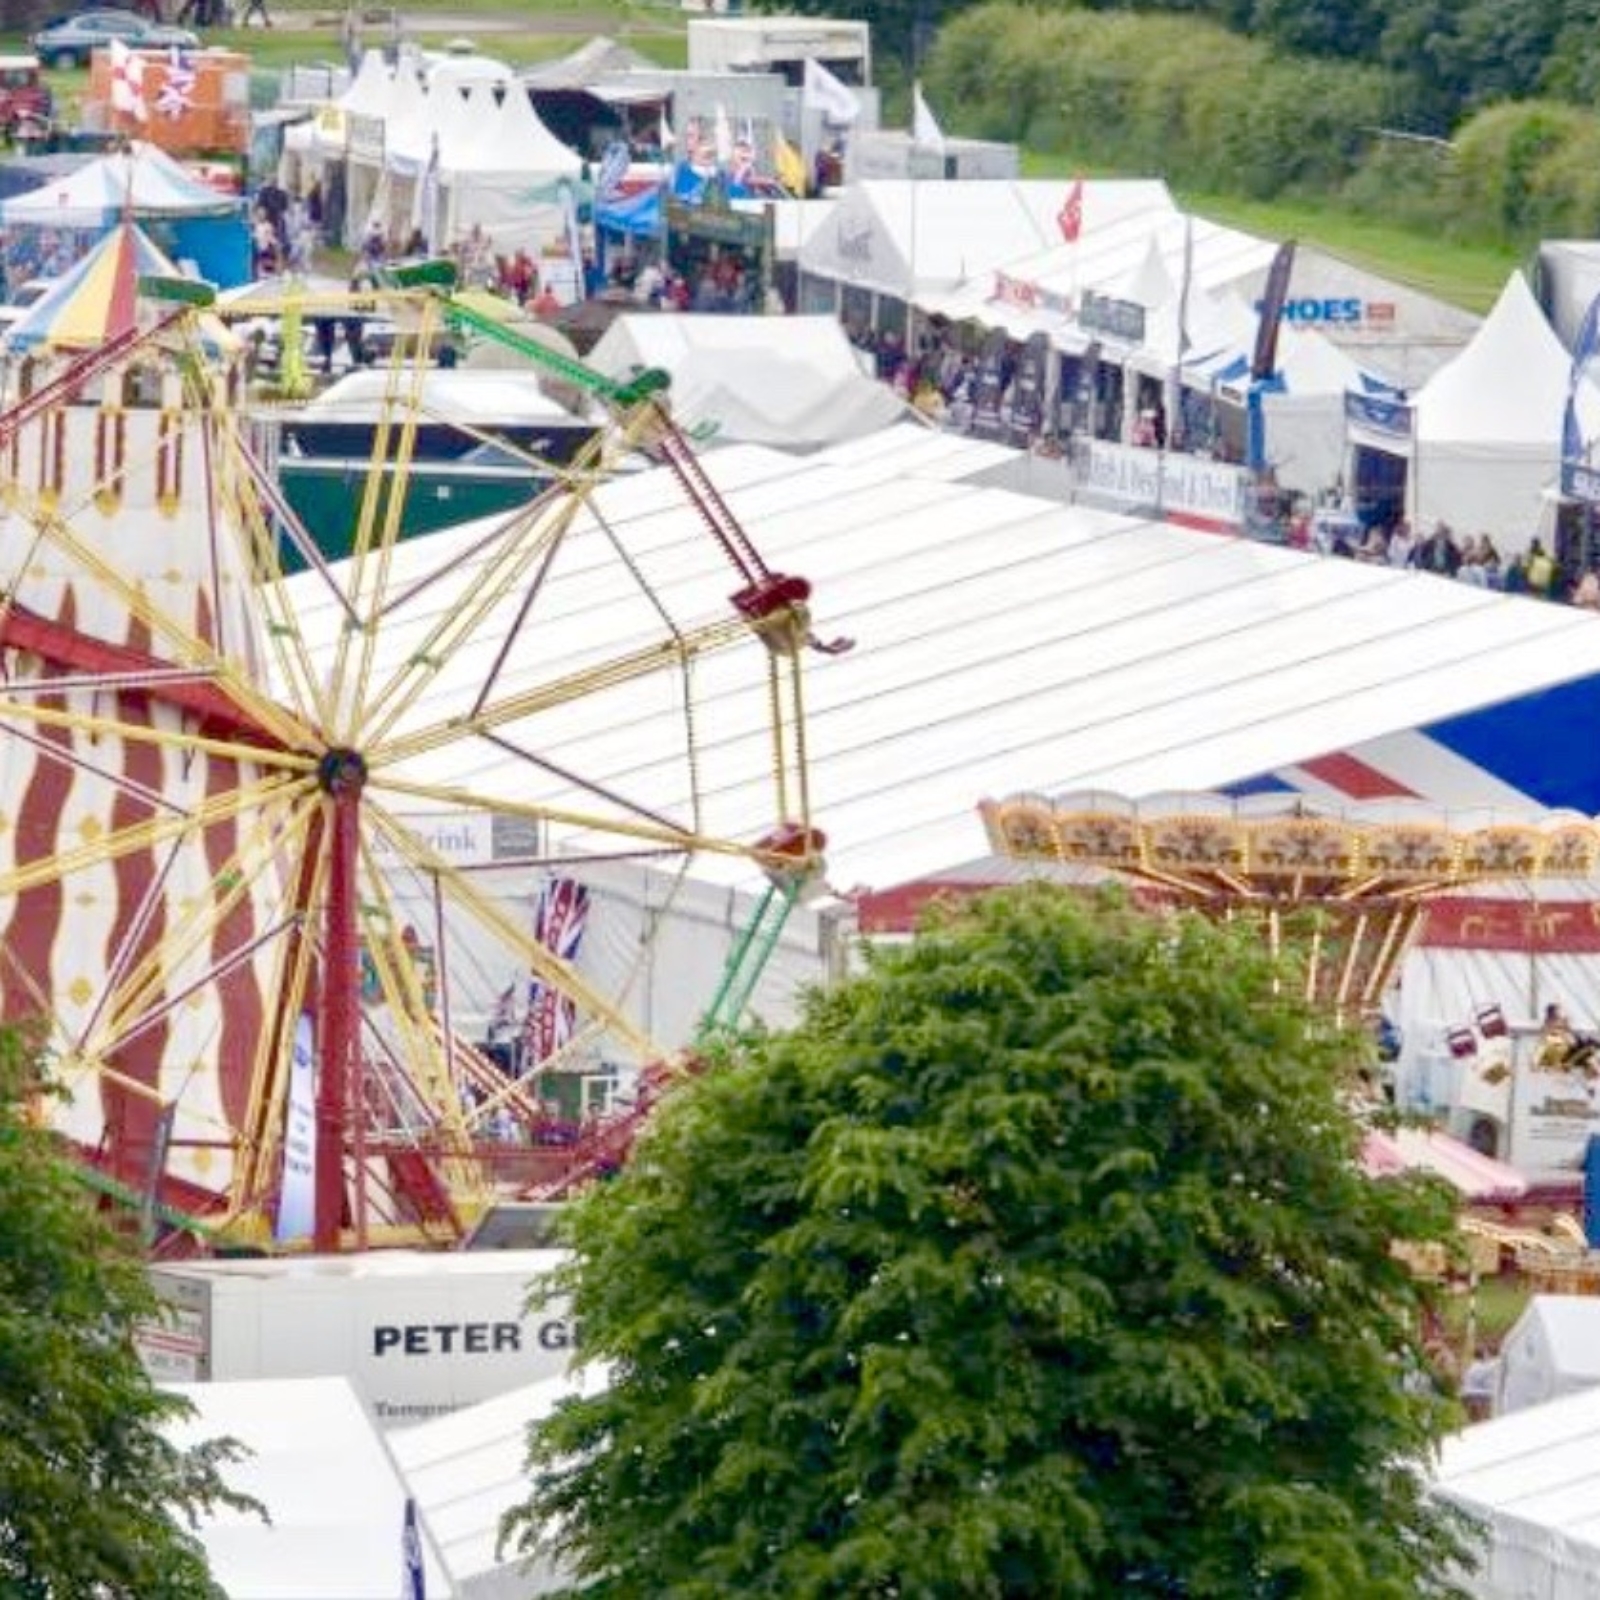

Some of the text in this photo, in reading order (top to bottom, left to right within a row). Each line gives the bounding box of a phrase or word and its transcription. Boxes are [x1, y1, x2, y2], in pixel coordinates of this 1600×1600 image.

[1256, 298, 1361, 321] HOES
[411, 825, 476, 851] rink
[374, 1324, 522, 1356] PETER
